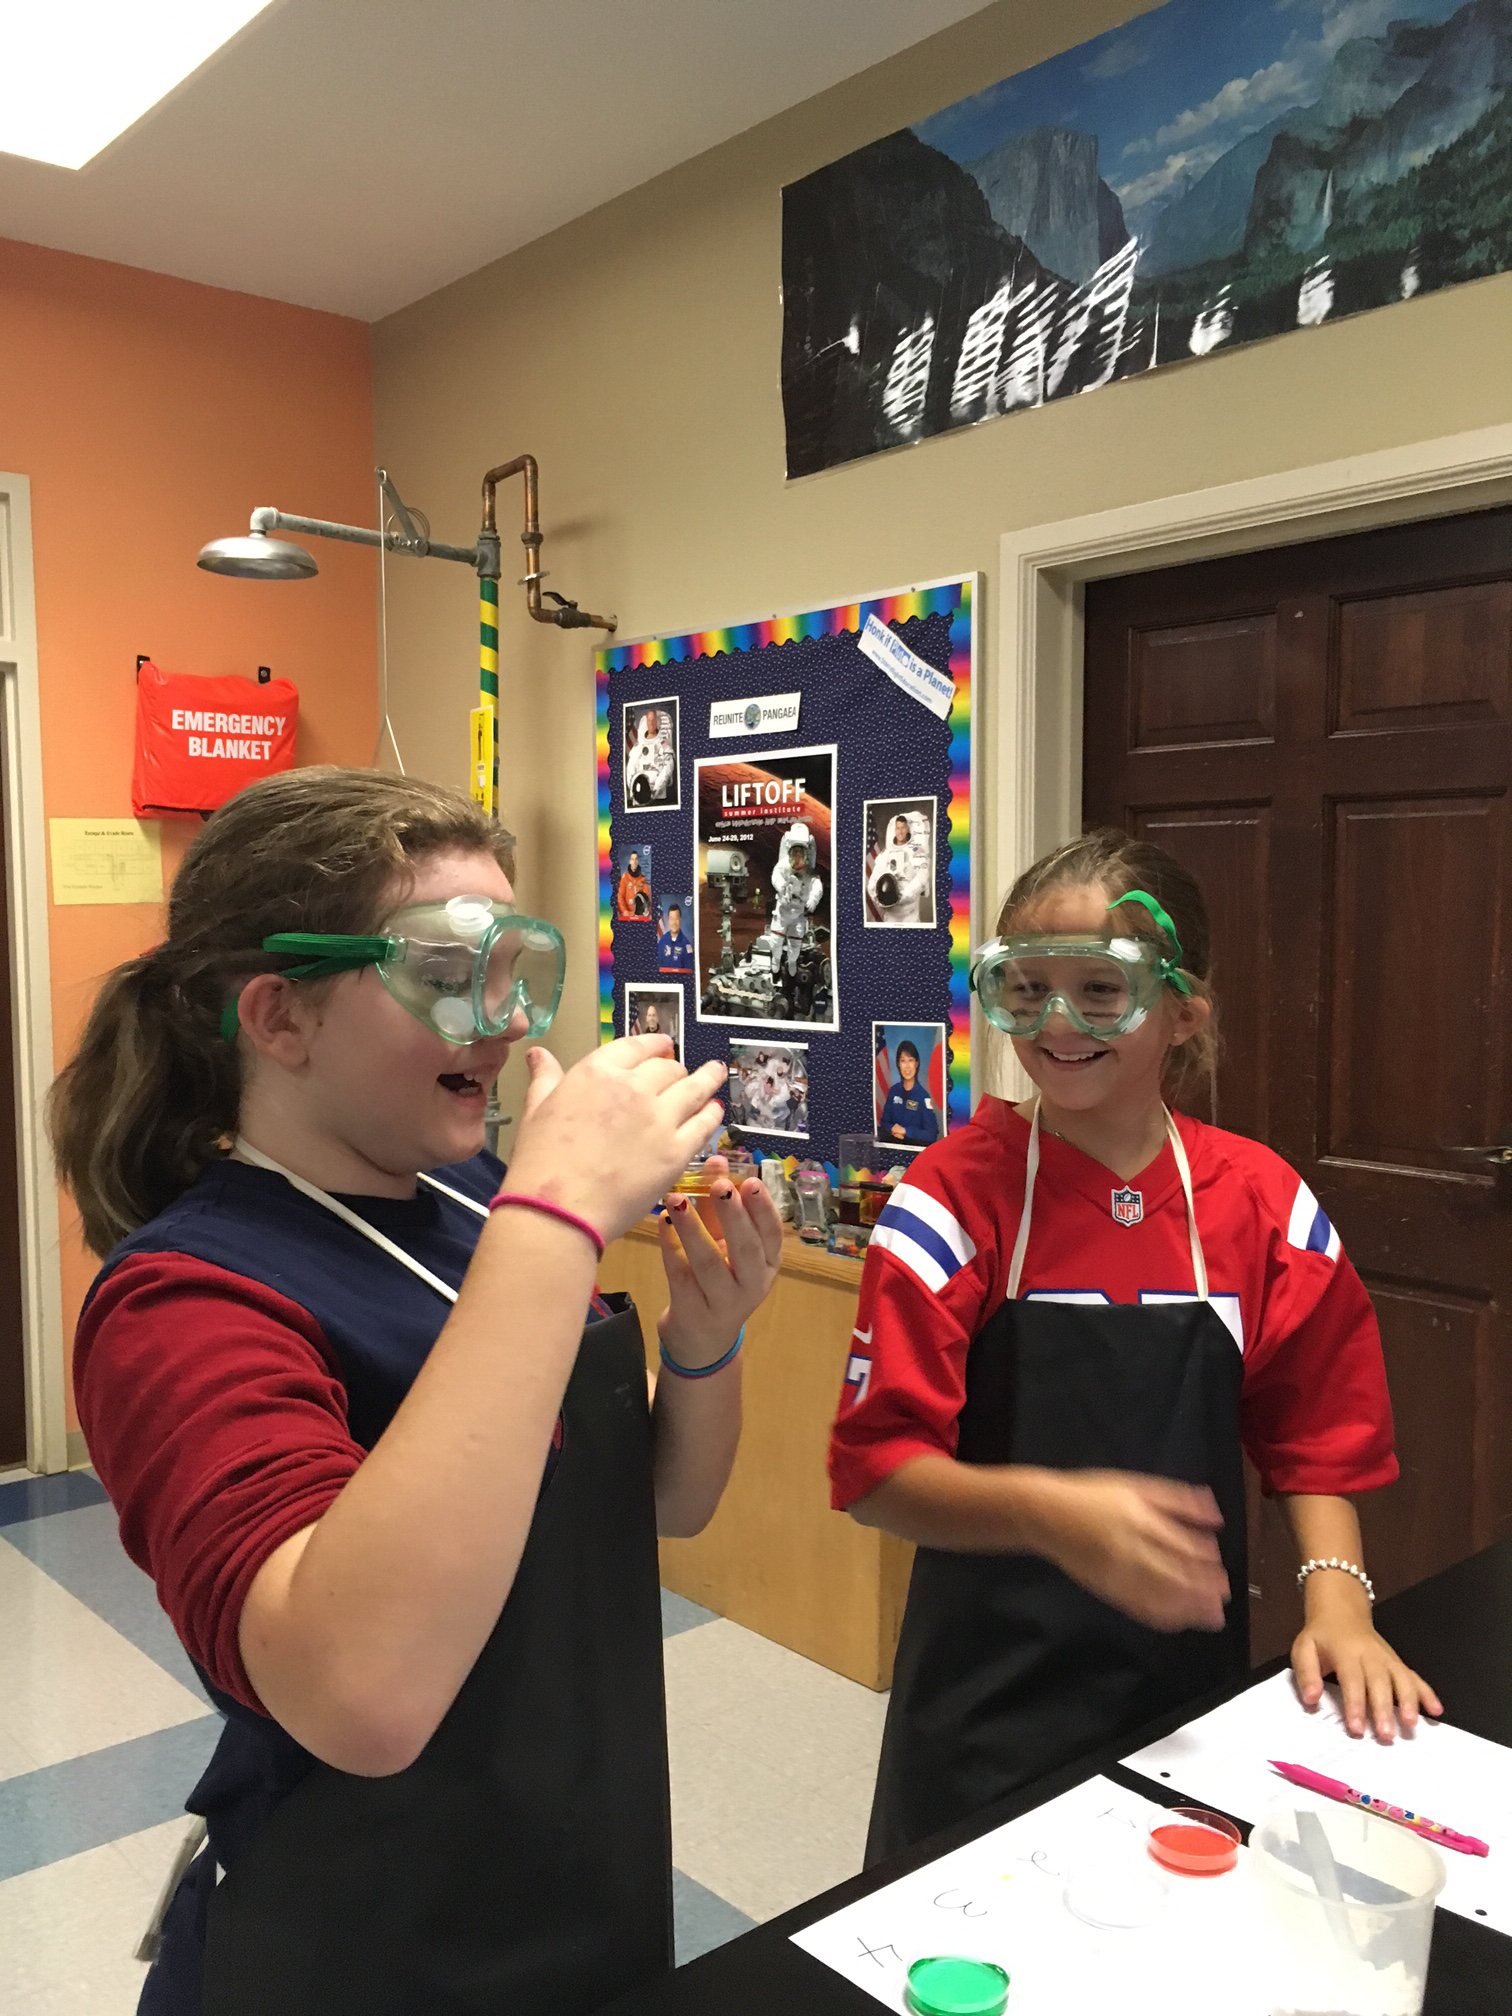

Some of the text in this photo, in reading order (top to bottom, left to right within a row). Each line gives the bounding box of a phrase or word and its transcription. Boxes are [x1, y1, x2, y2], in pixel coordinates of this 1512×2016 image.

[865, 618, 885, 643] Honk
[884, 634, 892, 648] if
[909, 658, 916, 673] is
[916, 667, 923, 678] a
[923, 669, 954, 699] Planet!
[172, 709, 286, 736] EMERGENCY
[713, 706, 796, 726] REUNITE PANGAEA
[188, 736, 272, 760] BLANKET
[722, 778, 806, 808] LIFTOFF
[724, 805, 801, 817] summer institute
[1117, 1203, 1139, 1218] NFL
